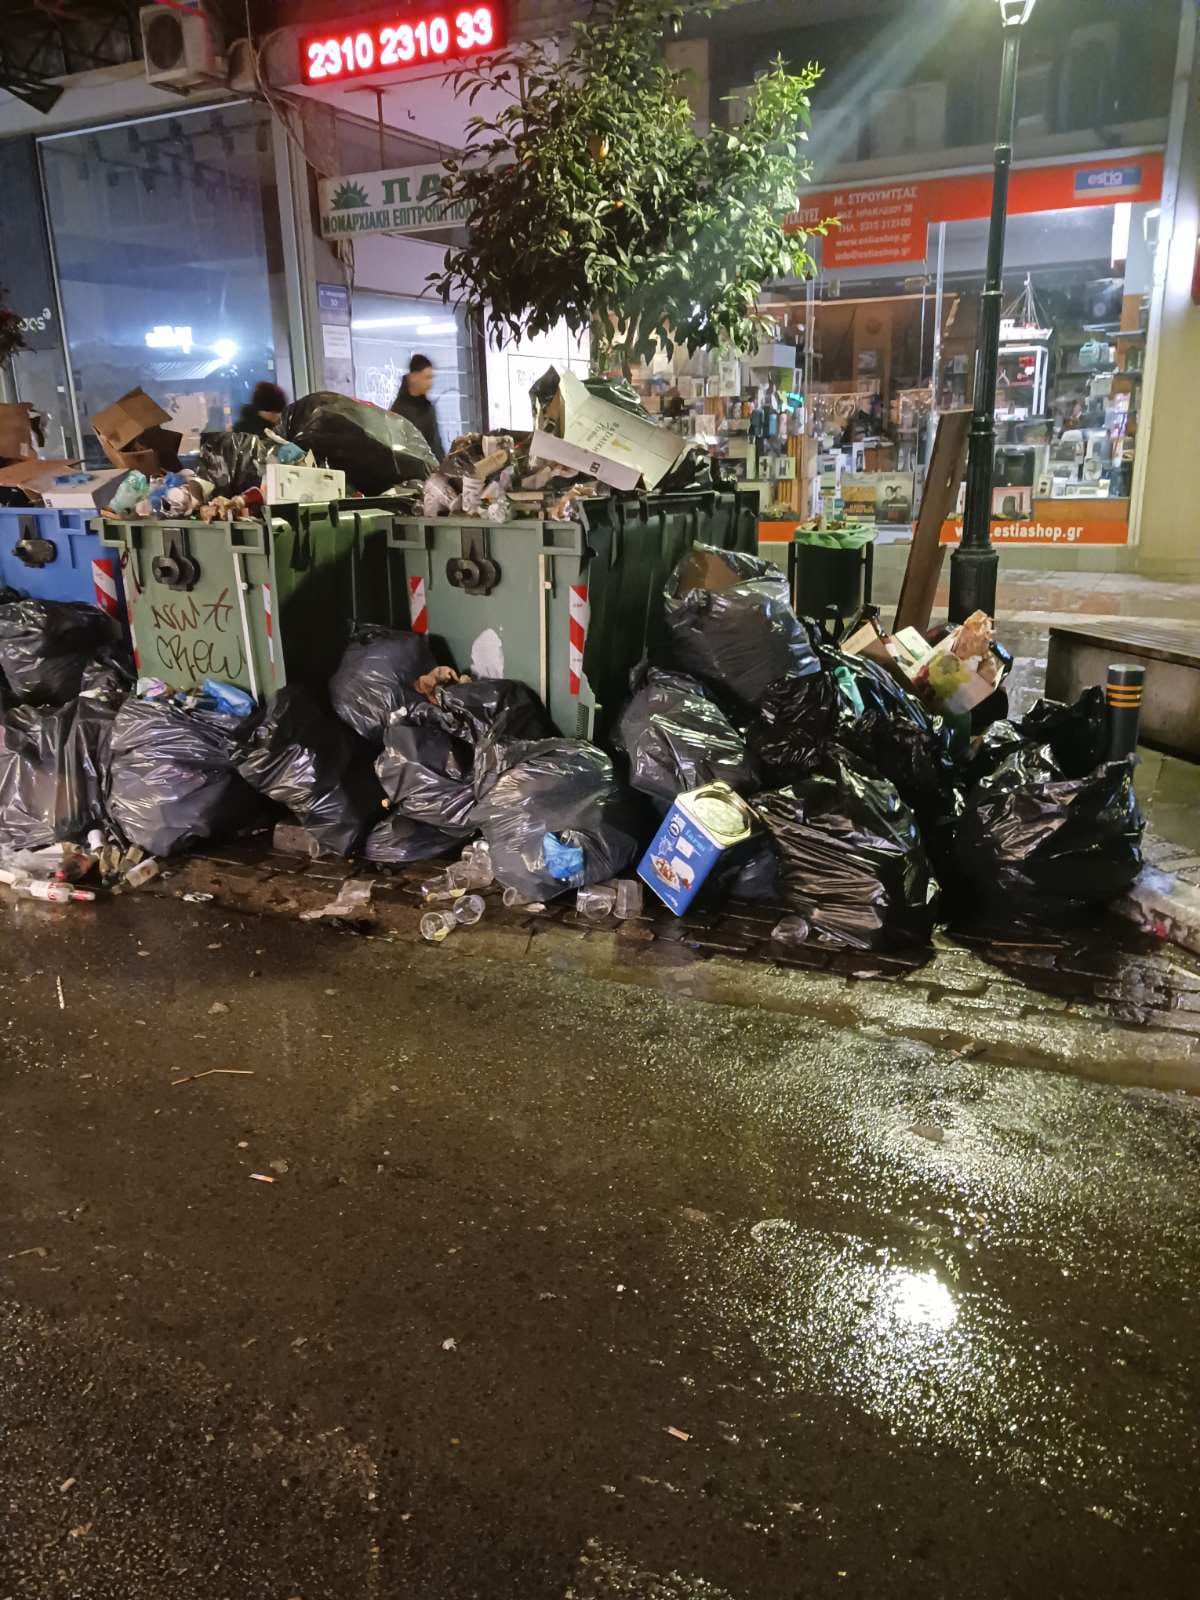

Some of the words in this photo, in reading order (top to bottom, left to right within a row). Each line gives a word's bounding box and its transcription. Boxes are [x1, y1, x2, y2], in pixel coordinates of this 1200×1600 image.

[308, 33, 374, 78] 2310
[379, 18, 449, 65] 2310
[455, 8, 494, 49] 33
